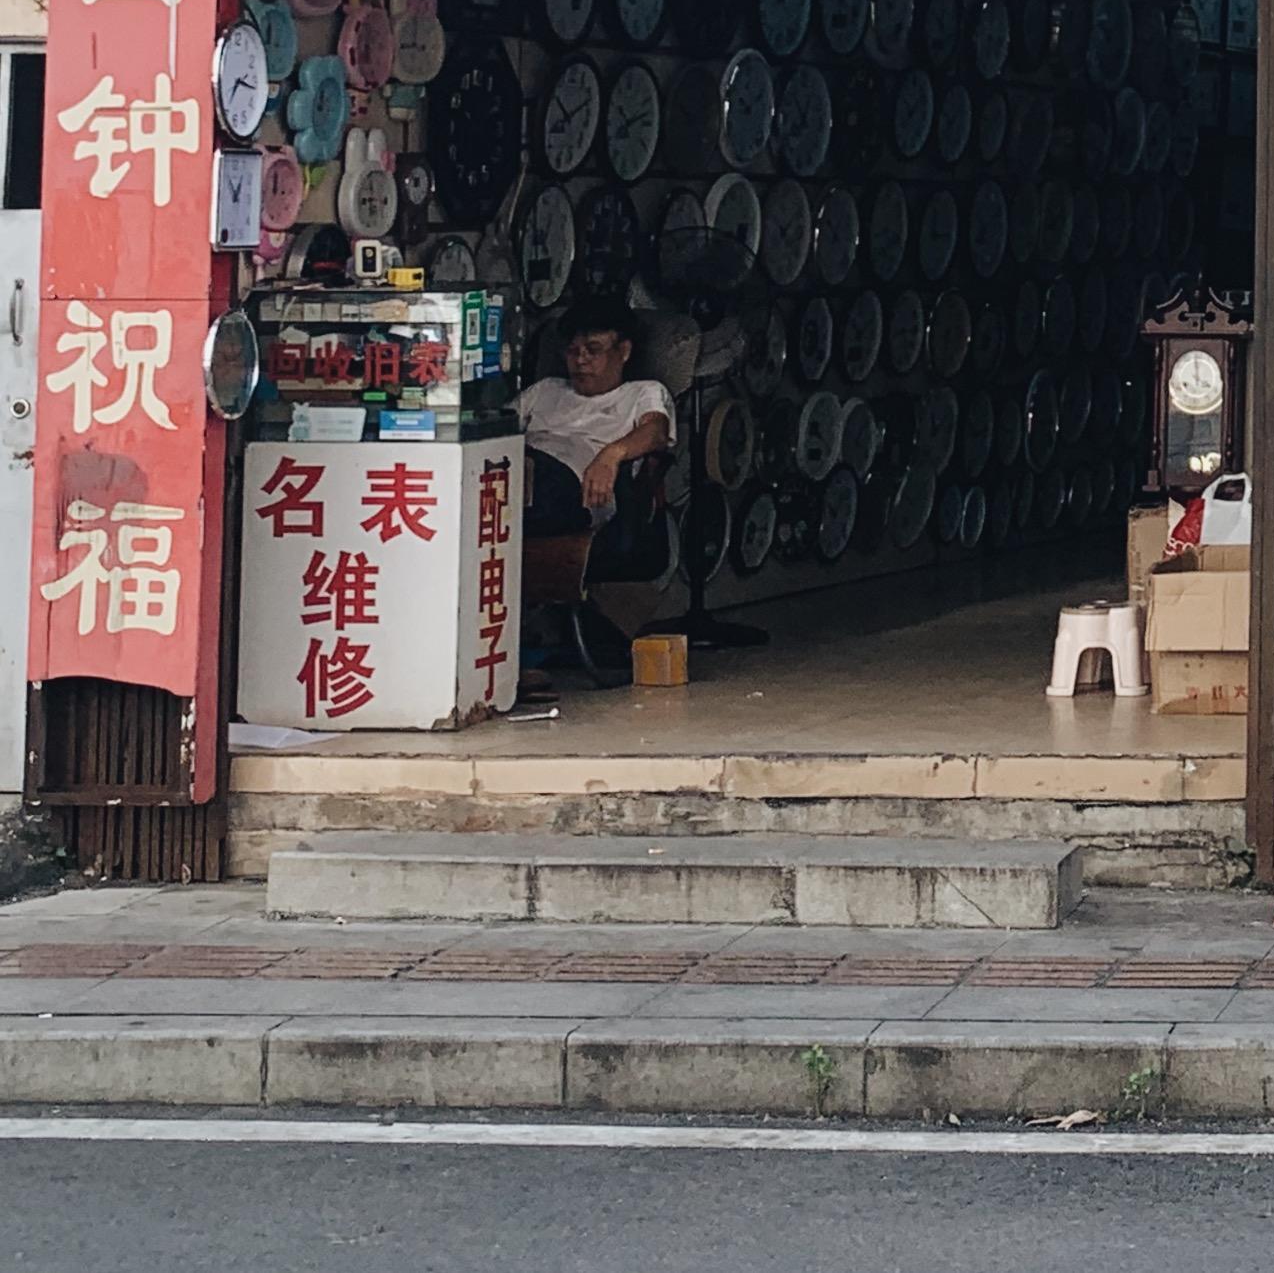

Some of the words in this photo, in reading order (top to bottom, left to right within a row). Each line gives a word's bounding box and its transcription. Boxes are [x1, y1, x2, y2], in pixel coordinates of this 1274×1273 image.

[268, 340, 451, 387] 回收旧表
[257, 457, 438, 544] 名表
[297, 549, 379, 719] 维修
